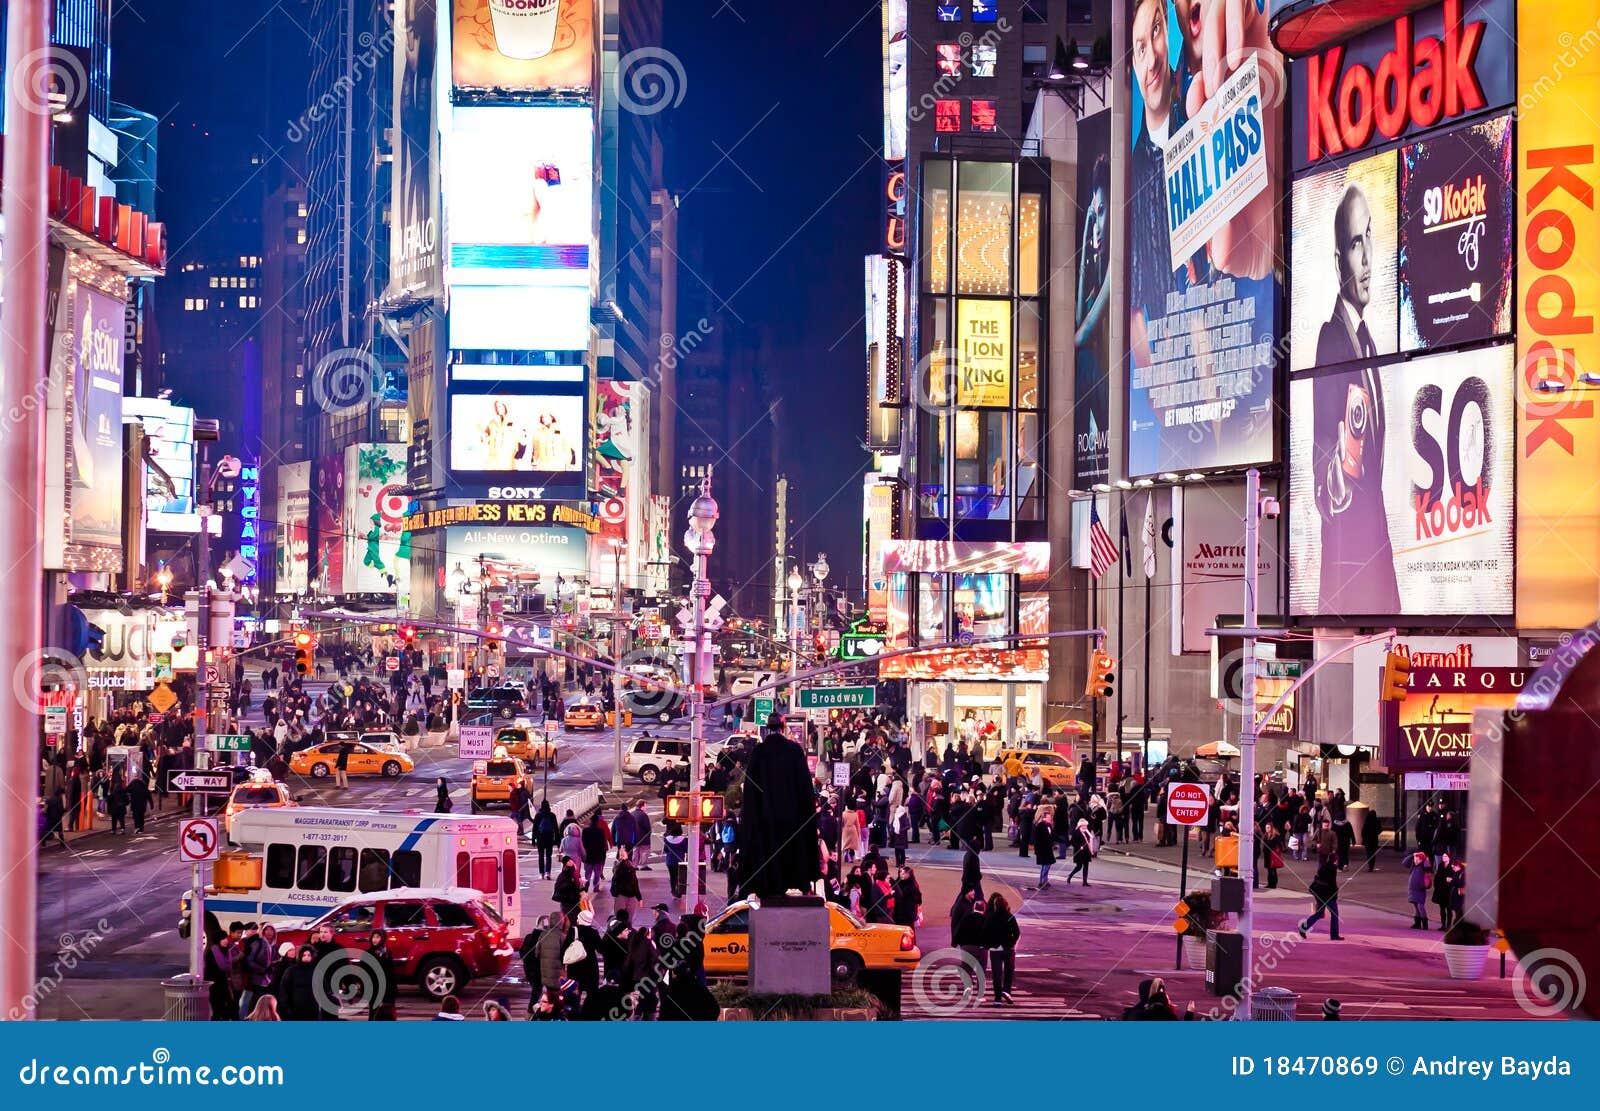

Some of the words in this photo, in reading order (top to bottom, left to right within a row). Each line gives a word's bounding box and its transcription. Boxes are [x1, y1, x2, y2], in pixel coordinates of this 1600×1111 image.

[1308, 0, 1488, 161] Kodak
[1168, 144, 1213, 232] HALL
[1211, 95, 1262, 190] PASS
[1443, 174, 1487, 221] Kodak
[1526, 144, 1594, 459] Kodak
[969, 319, 998, 334] THE
[94, 329, 120, 376] SEOUL
[964, 338, 1004, 363] LION
[963, 366, 1005, 392] KING
[1411, 376, 1493, 514] SO
[488, 487, 545, 499] SONY
[507, 504, 546, 522] NEWS
[1415, 476, 1493, 540] Kodak
[464, 532, 516, 544] All-New
[519, 531, 569, 547] Optima
[811, 692, 864, 705] Broadway
[219, 737, 227, 750] W
[226, 737, 240, 750] 46
[177, 776, 195, 786] ONE
[203, 776, 223, 786] WAY
[1175, 791, 1186, 799] DO
[1187, 791, 1202, 799] NOT
[1176, 808, 1199, 817] ENTER
[288, 893, 339, 904] ACCESS-A-RIDE
